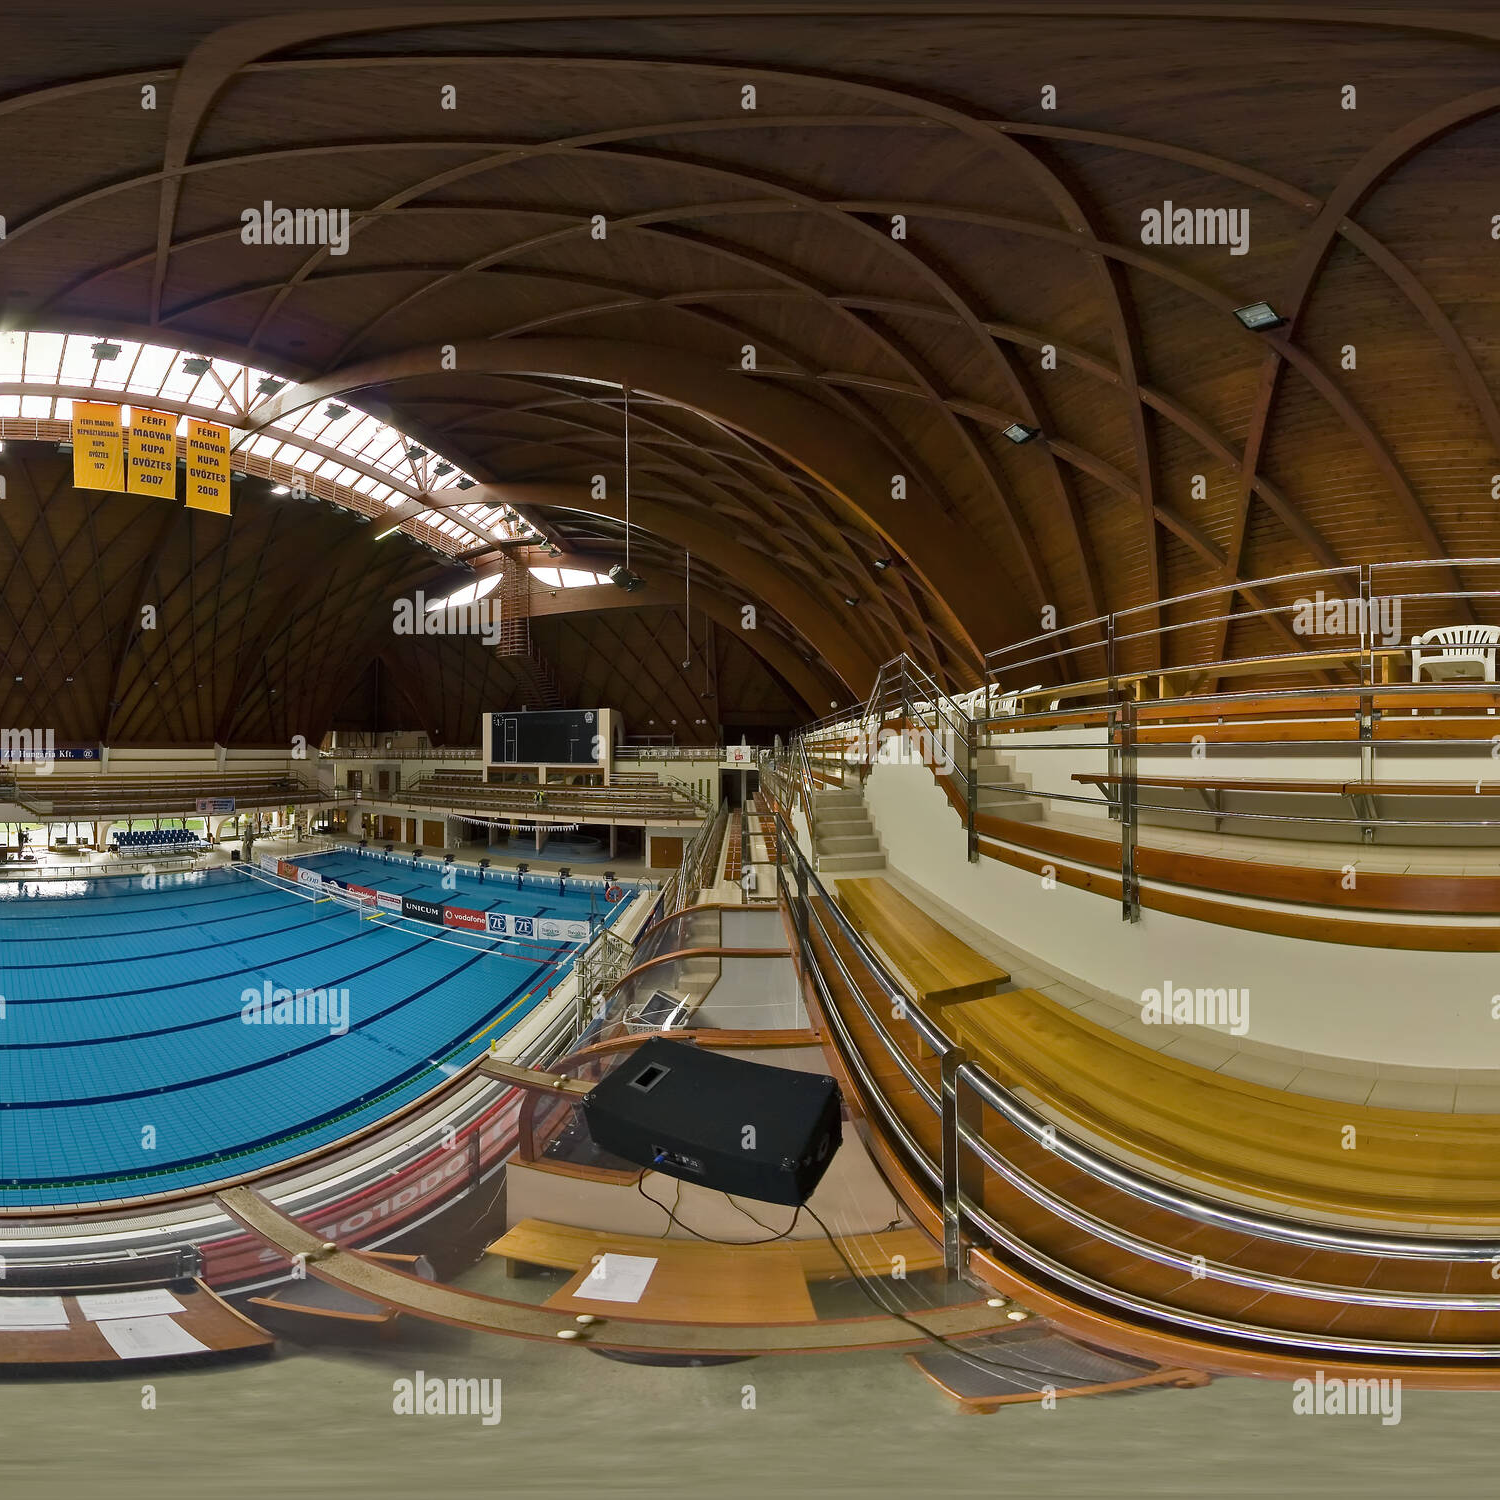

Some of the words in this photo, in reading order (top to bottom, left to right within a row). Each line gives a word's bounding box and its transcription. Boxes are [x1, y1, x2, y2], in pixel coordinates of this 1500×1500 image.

[133, 428, 172, 441] MAGYAR
[141, 443, 164, 454] KUPA
[190, 439, 226, 453] MAGYAR
[197, 455, 219, 467] KUPA
[140, 474, 163, 485] 2007
[197, 485, 218, 496] 2008
[406, 902, 439, 916] UNICUM
[454, 913, 485, 924] vodafone
[492, 917, 503, 929] ZF
[519, 920, 530, 932] ZF
